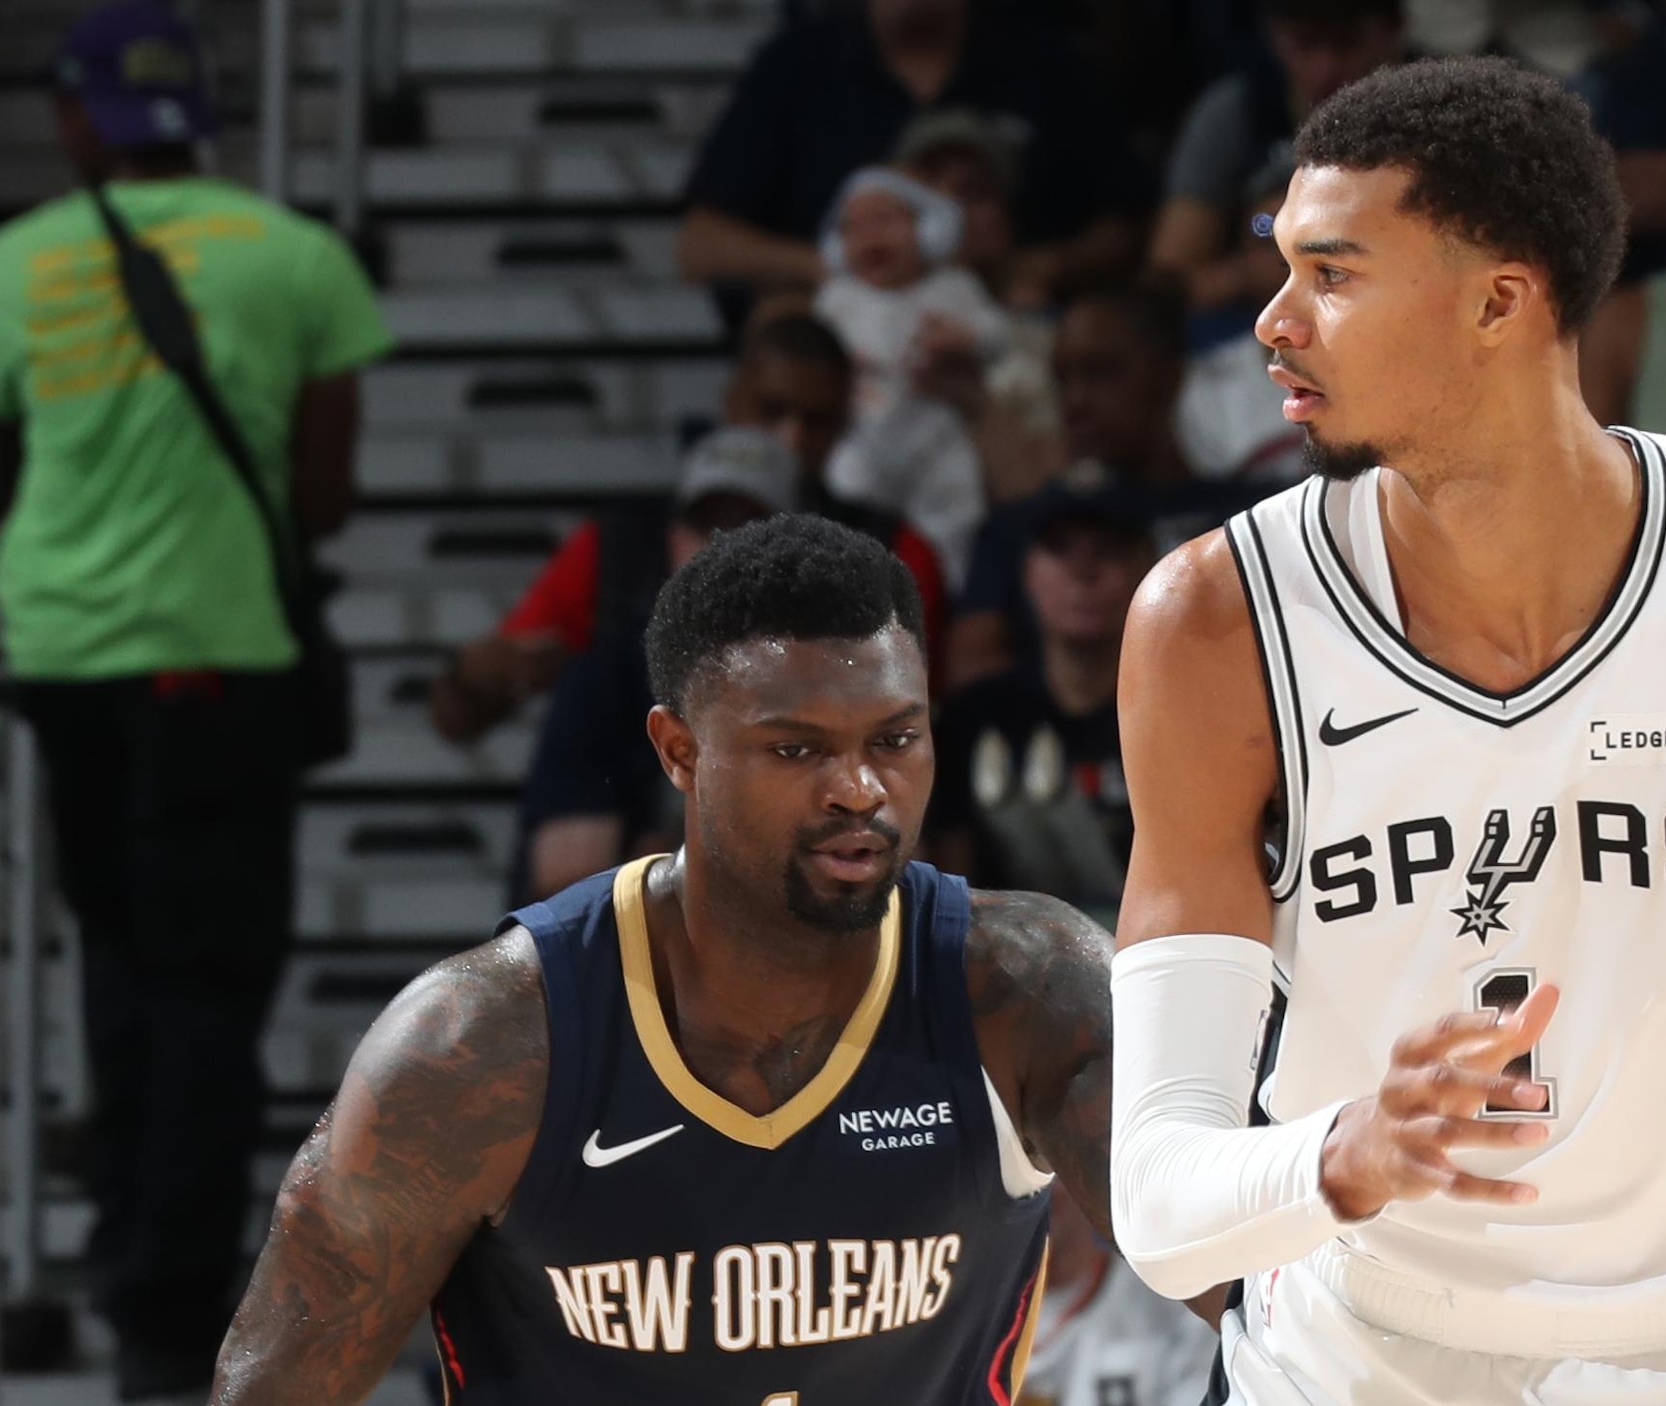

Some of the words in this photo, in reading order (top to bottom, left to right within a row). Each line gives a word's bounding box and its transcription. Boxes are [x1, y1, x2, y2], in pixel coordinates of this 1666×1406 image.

[839, 1101, 953, 1134] NEWAGE
[861, 1131, 936, 1152] GARAGE
[544, 1250, 696, 1353] NEW
[711, 1232, 962, 1353] ORLEANS
